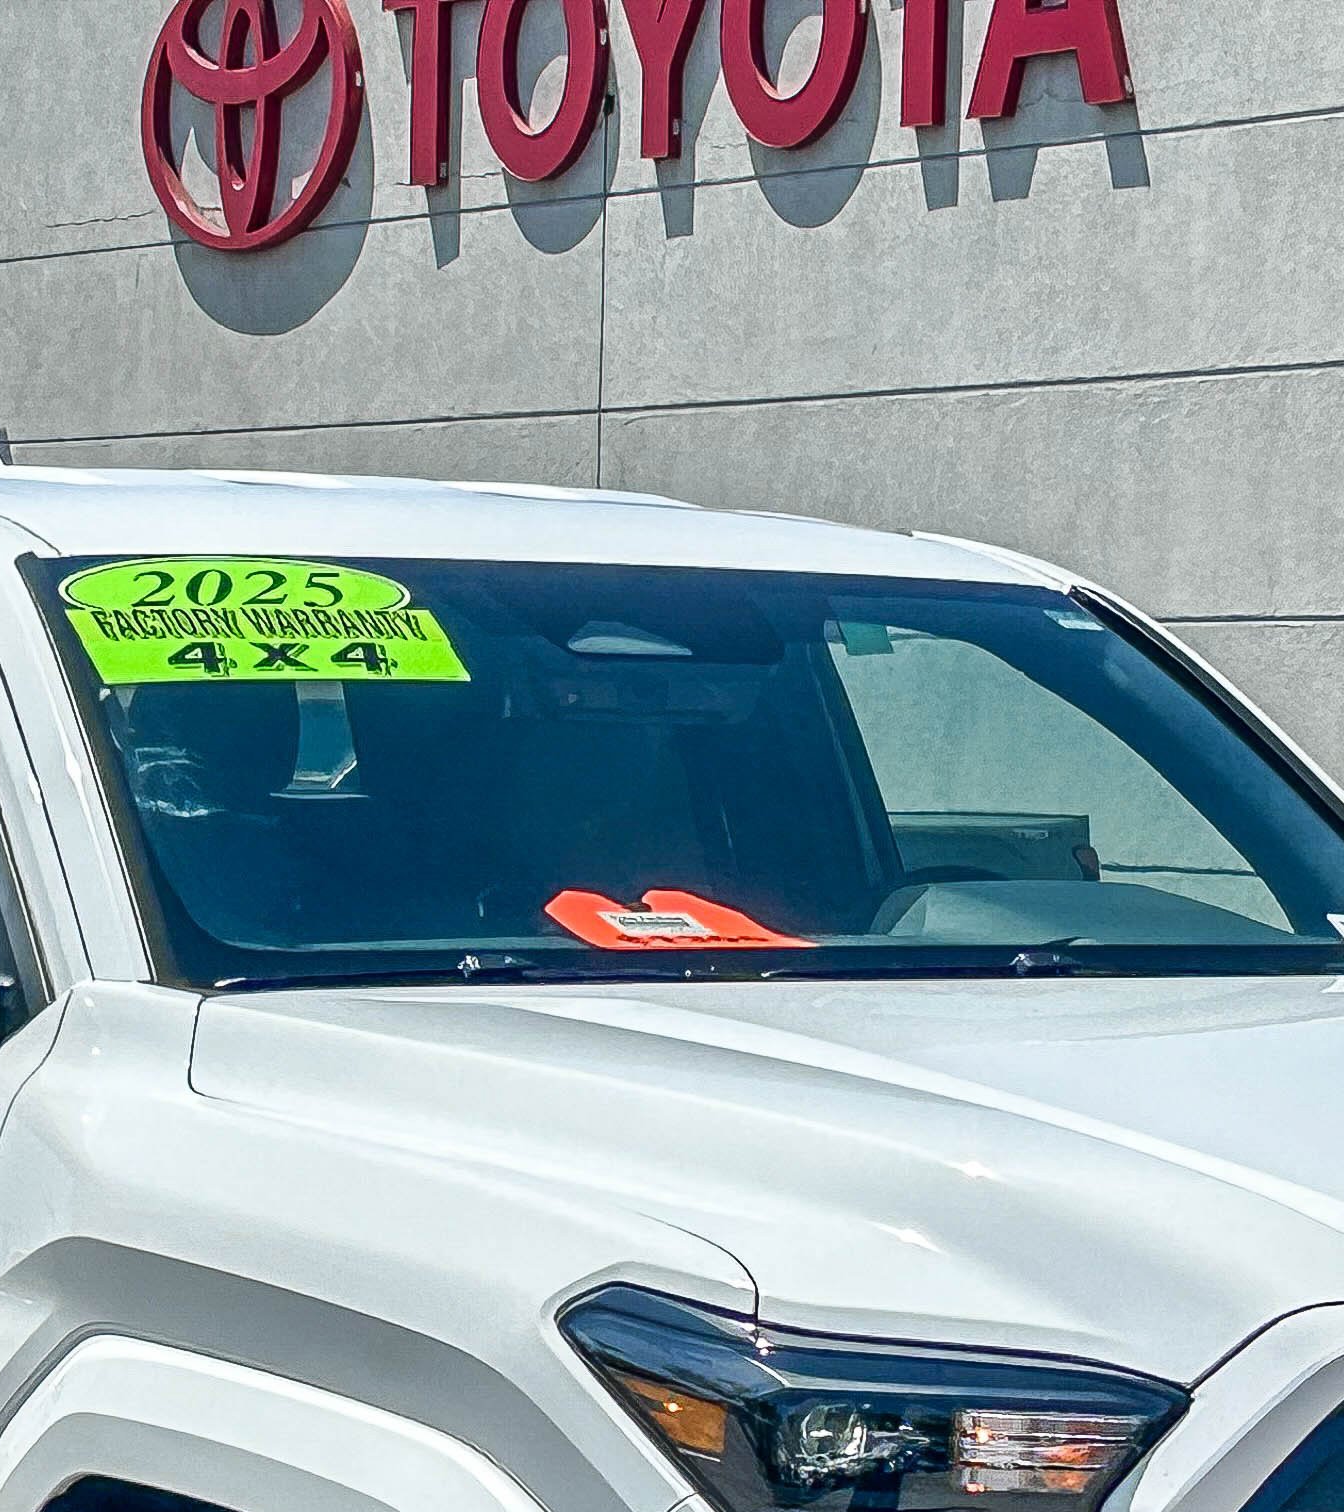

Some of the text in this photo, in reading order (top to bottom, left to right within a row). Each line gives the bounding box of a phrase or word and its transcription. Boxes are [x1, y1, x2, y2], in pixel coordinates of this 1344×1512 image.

[131, 569, 344, 608] 2025
[91, 606, 430, 642] FACTORY WARRANTY
